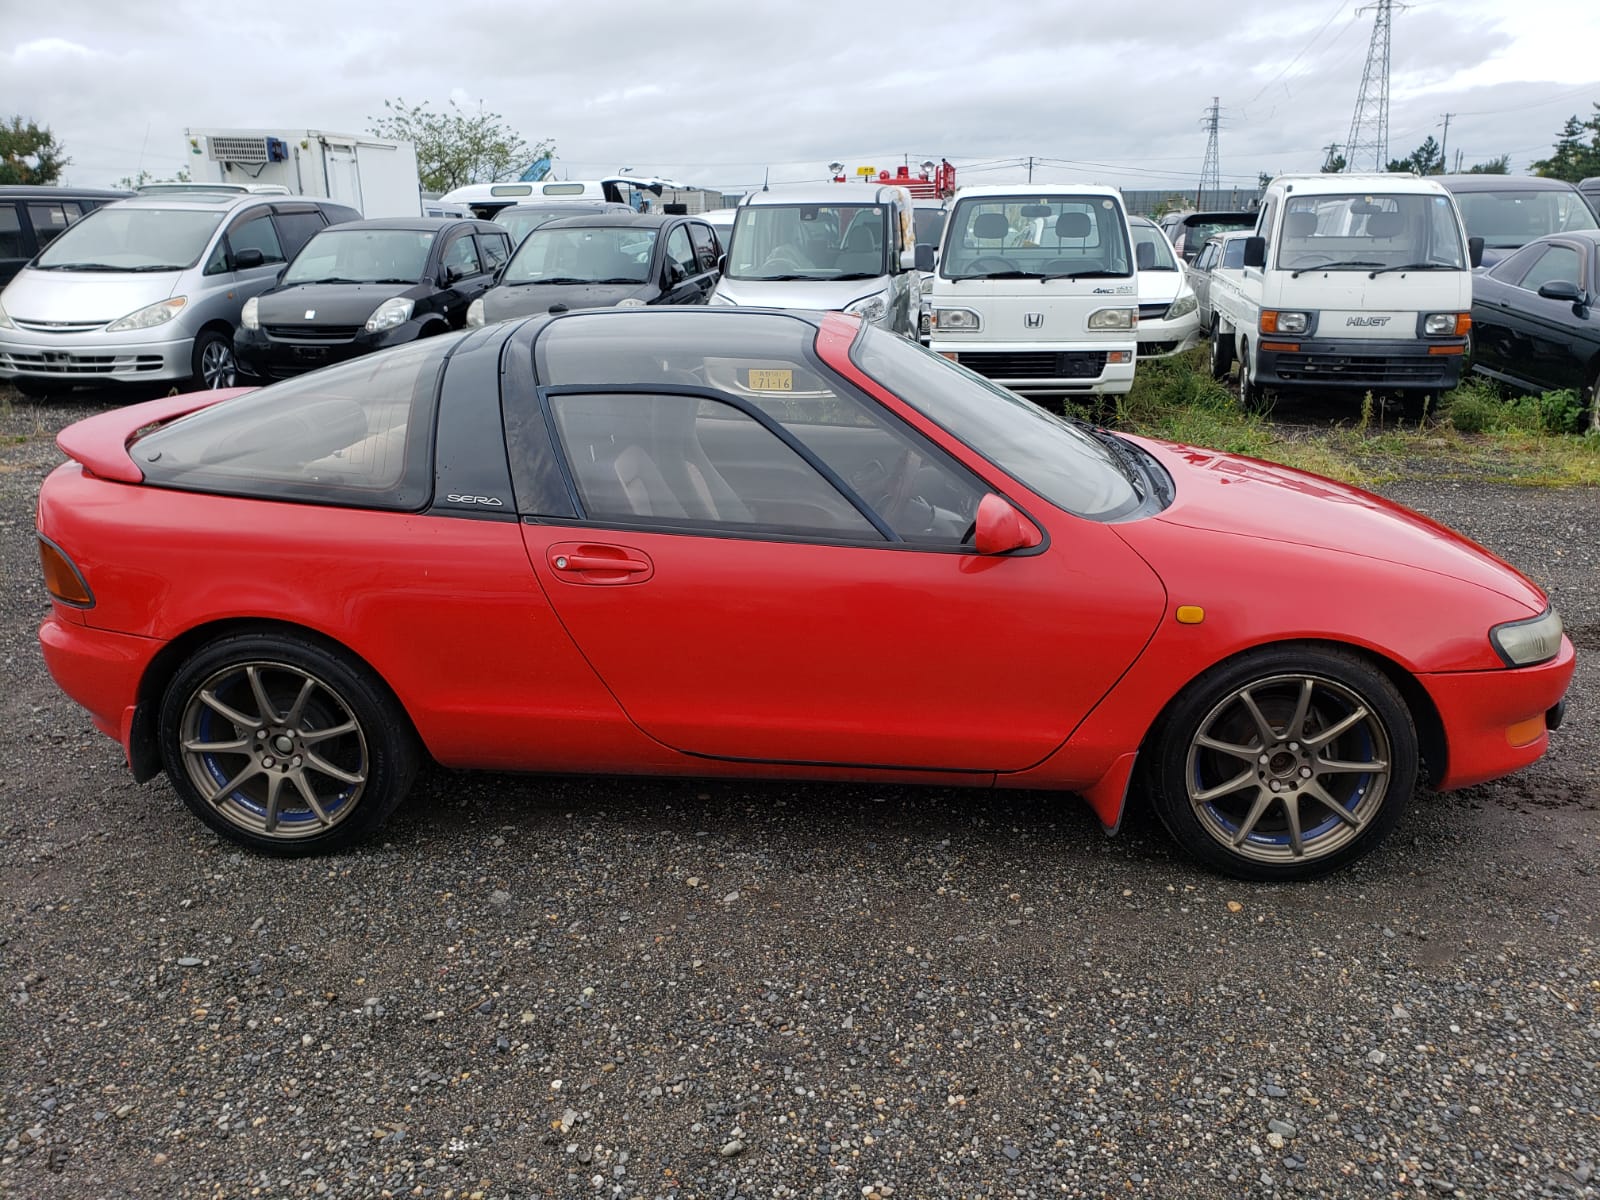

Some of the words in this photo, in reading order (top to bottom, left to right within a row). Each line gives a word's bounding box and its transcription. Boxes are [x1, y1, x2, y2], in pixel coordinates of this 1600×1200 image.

[1346, 316, 1391, 327] HIJET
[759, 377, 790, 389] 71-16
[446, 494, 503, 506] SERA
